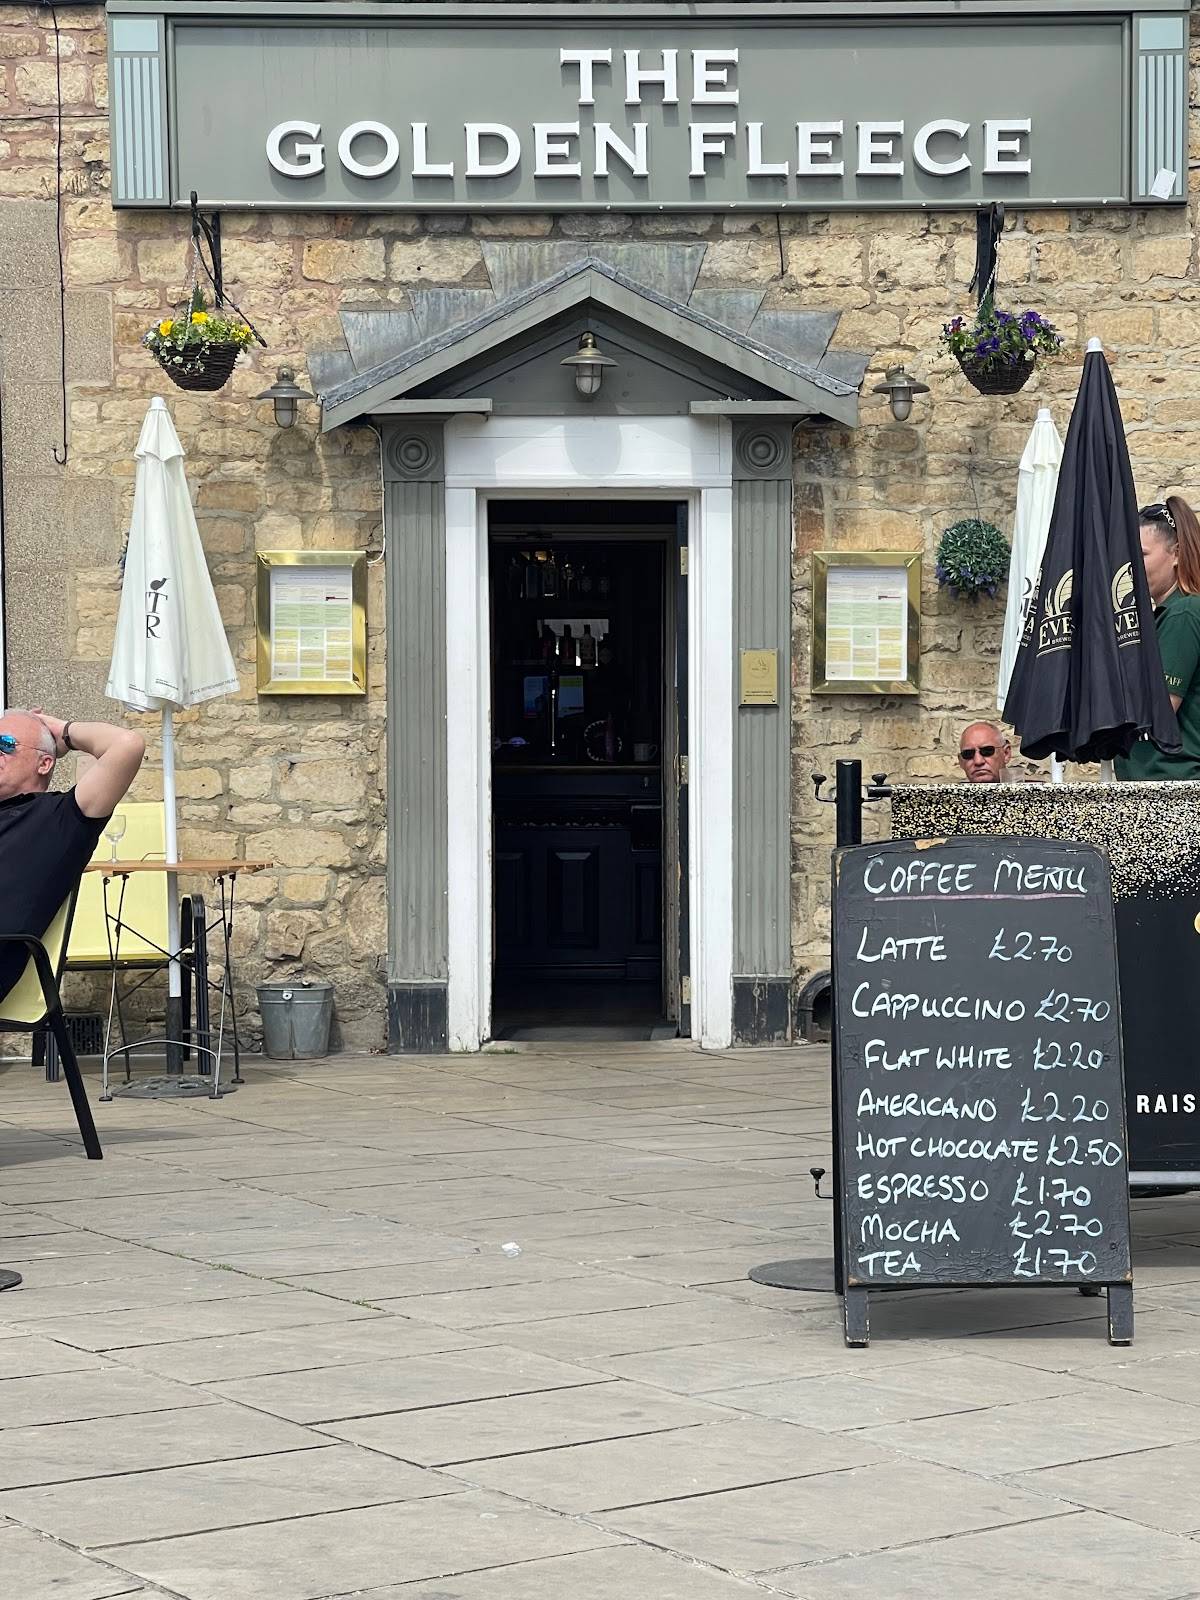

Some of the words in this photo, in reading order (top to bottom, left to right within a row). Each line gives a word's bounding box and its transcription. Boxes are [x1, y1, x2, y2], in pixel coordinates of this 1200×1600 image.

[560, 48, 740, 104] THE
[266, 120, 649, 178] GOLDEN
[689, 119, 1032, 176] FLEECE
[864, 858, 977, 894] COFFEE
[993, 860, 1088, 893] MENU
[856, 927, 948, 962] LATTE
[988, 928, 1073, 962] £2.70
[852, 982, 1026, 1022] CAPPUCCINO
[1034, 989, 1111, 1022] £2.70
[865, 1039, 930, 1071] FLAT
[936, 1046, 1012, 1070] WHITE
[857, 1088, 997, 1122] AMERICANO
[1136, 1094, 1196, 1114] RAIS
[856, 1132, 907, 1160] HOT
[910, 1137, 1039, 1162] CHOCOLATE
[1046, 1135, 1123, 1166] £2.50
[858, 1173, 989, 1204] ESPRESSO
[1011, 1172, 1092, 1206] £1.70
[861, 1214, 960, 1244] MOCHA
[1009, 1210, 1103, 1239] £2.70
[858, 1250, 921, 1277] TEA
[1013, 1241, 1097, 1277] £1.70
